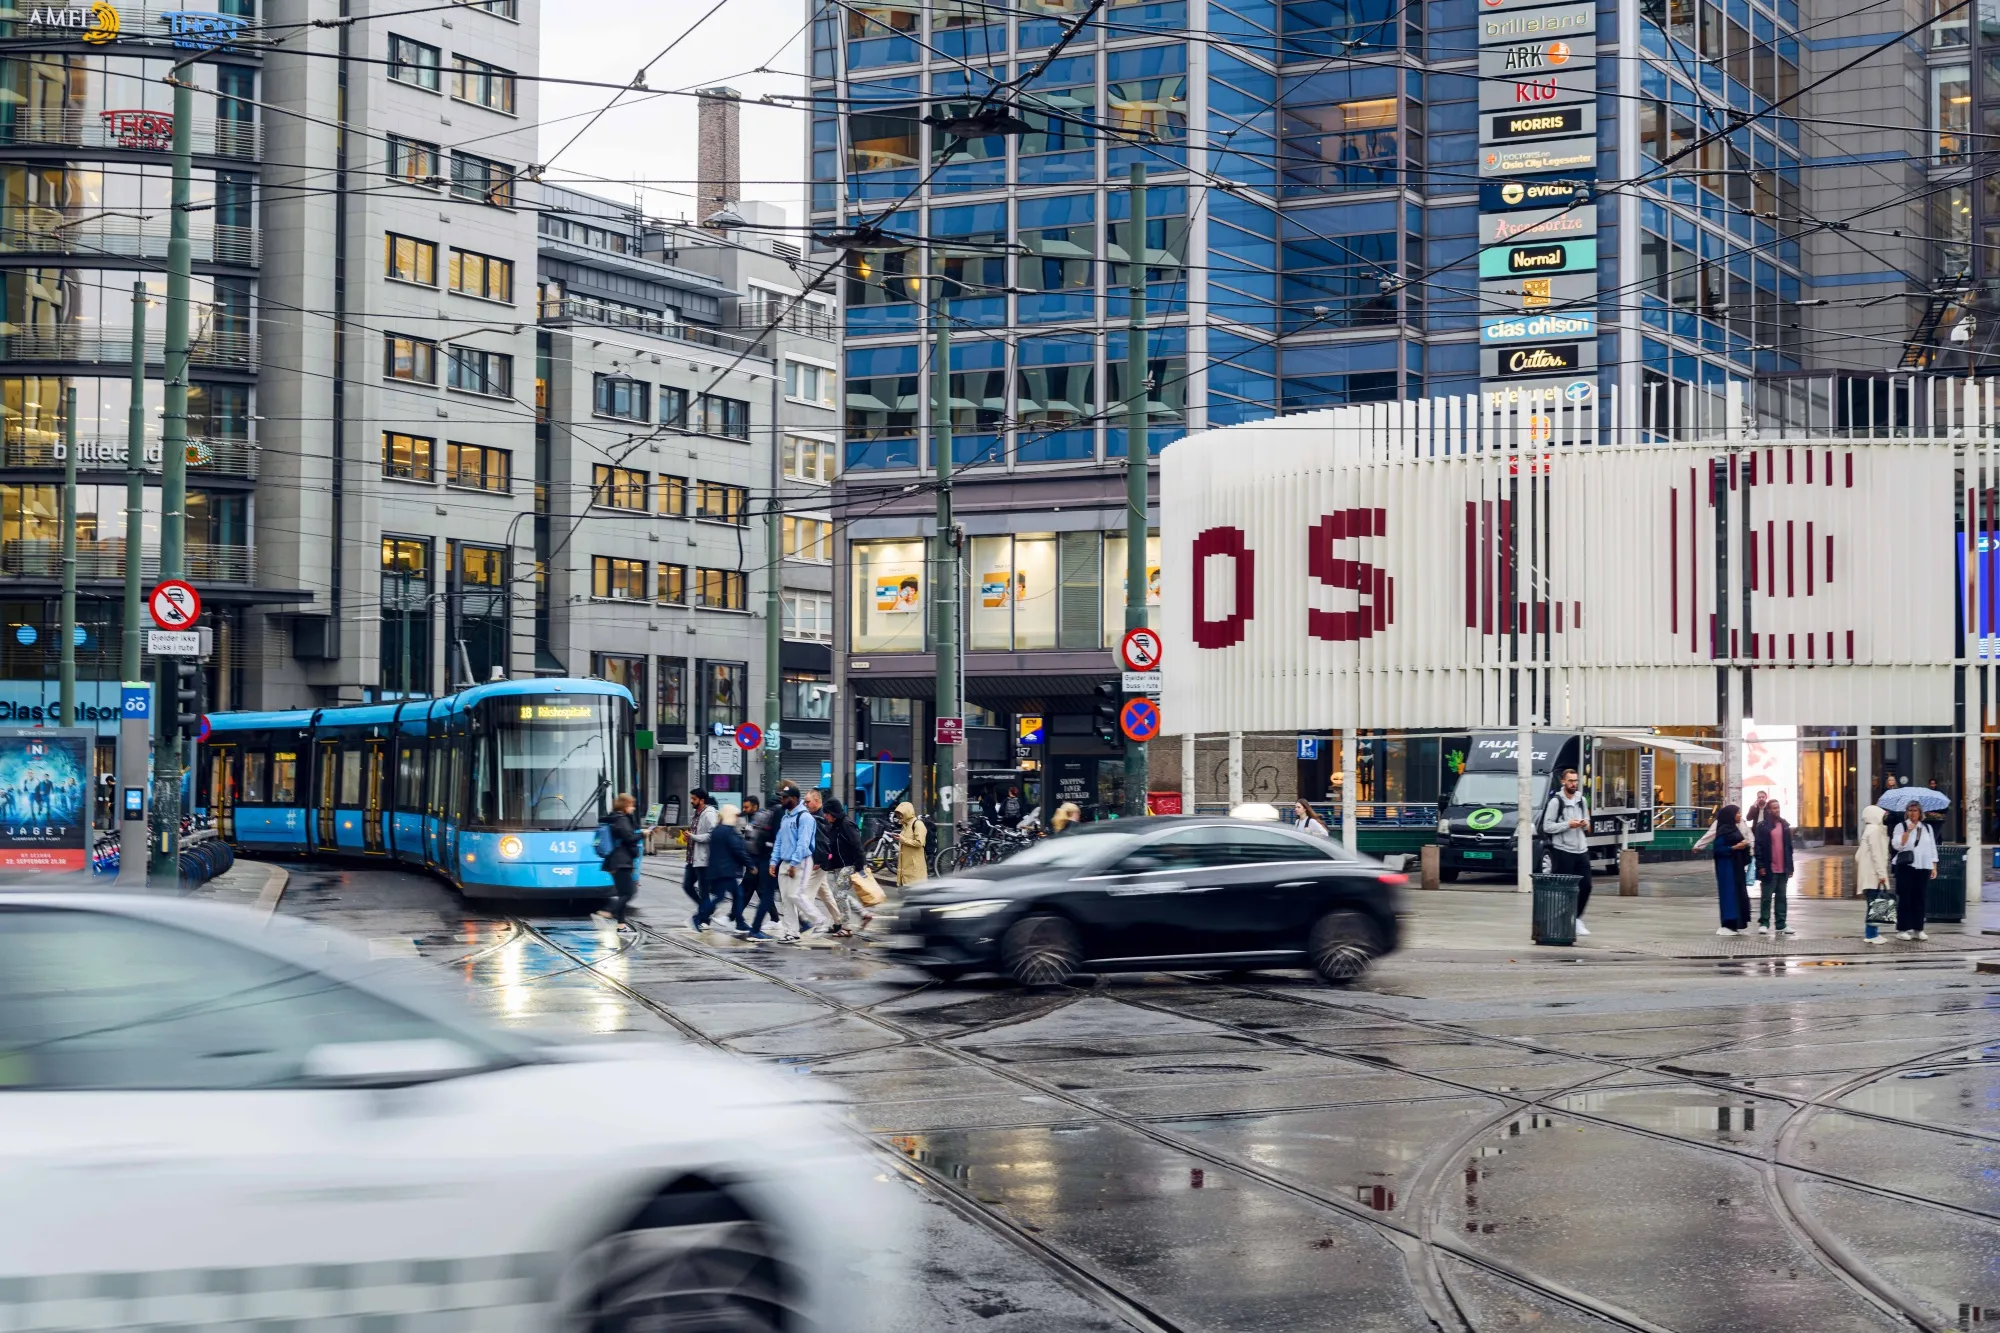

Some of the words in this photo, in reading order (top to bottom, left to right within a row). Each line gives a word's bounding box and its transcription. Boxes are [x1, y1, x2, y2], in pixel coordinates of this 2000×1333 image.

[28, 6, 87, 28] AMFI
[160, 11, 249, 40] THON
[1486, 10, 1589, 36] brilleland
[1505, 44, 1544, 70] ARK
[1510, 116, 1563, 132] MORRIS
[118, 136, 169, 149] HOTELS
[1502, 161, 1524, 170] Oslo
[1525, 159, 1542, 168] City
[1543, 155, 1592, 167] Legesenter
[1495, 213, 1582, 239] Accessorize
[1514, 249, 1561, 268] Normal
[1487, 320, 1526, 338] clas
[1527, 317, 1589, 335] ohlson
[0, 701, 44, 720] Clas
[520, 705, 533, 719] 18
[538, 705, 592, 720] Rikshospitalet
[1016, 747, 1031, 757] 157
[1301, 738, 1313, 752] P
[549, 840, 577, 854] 415
